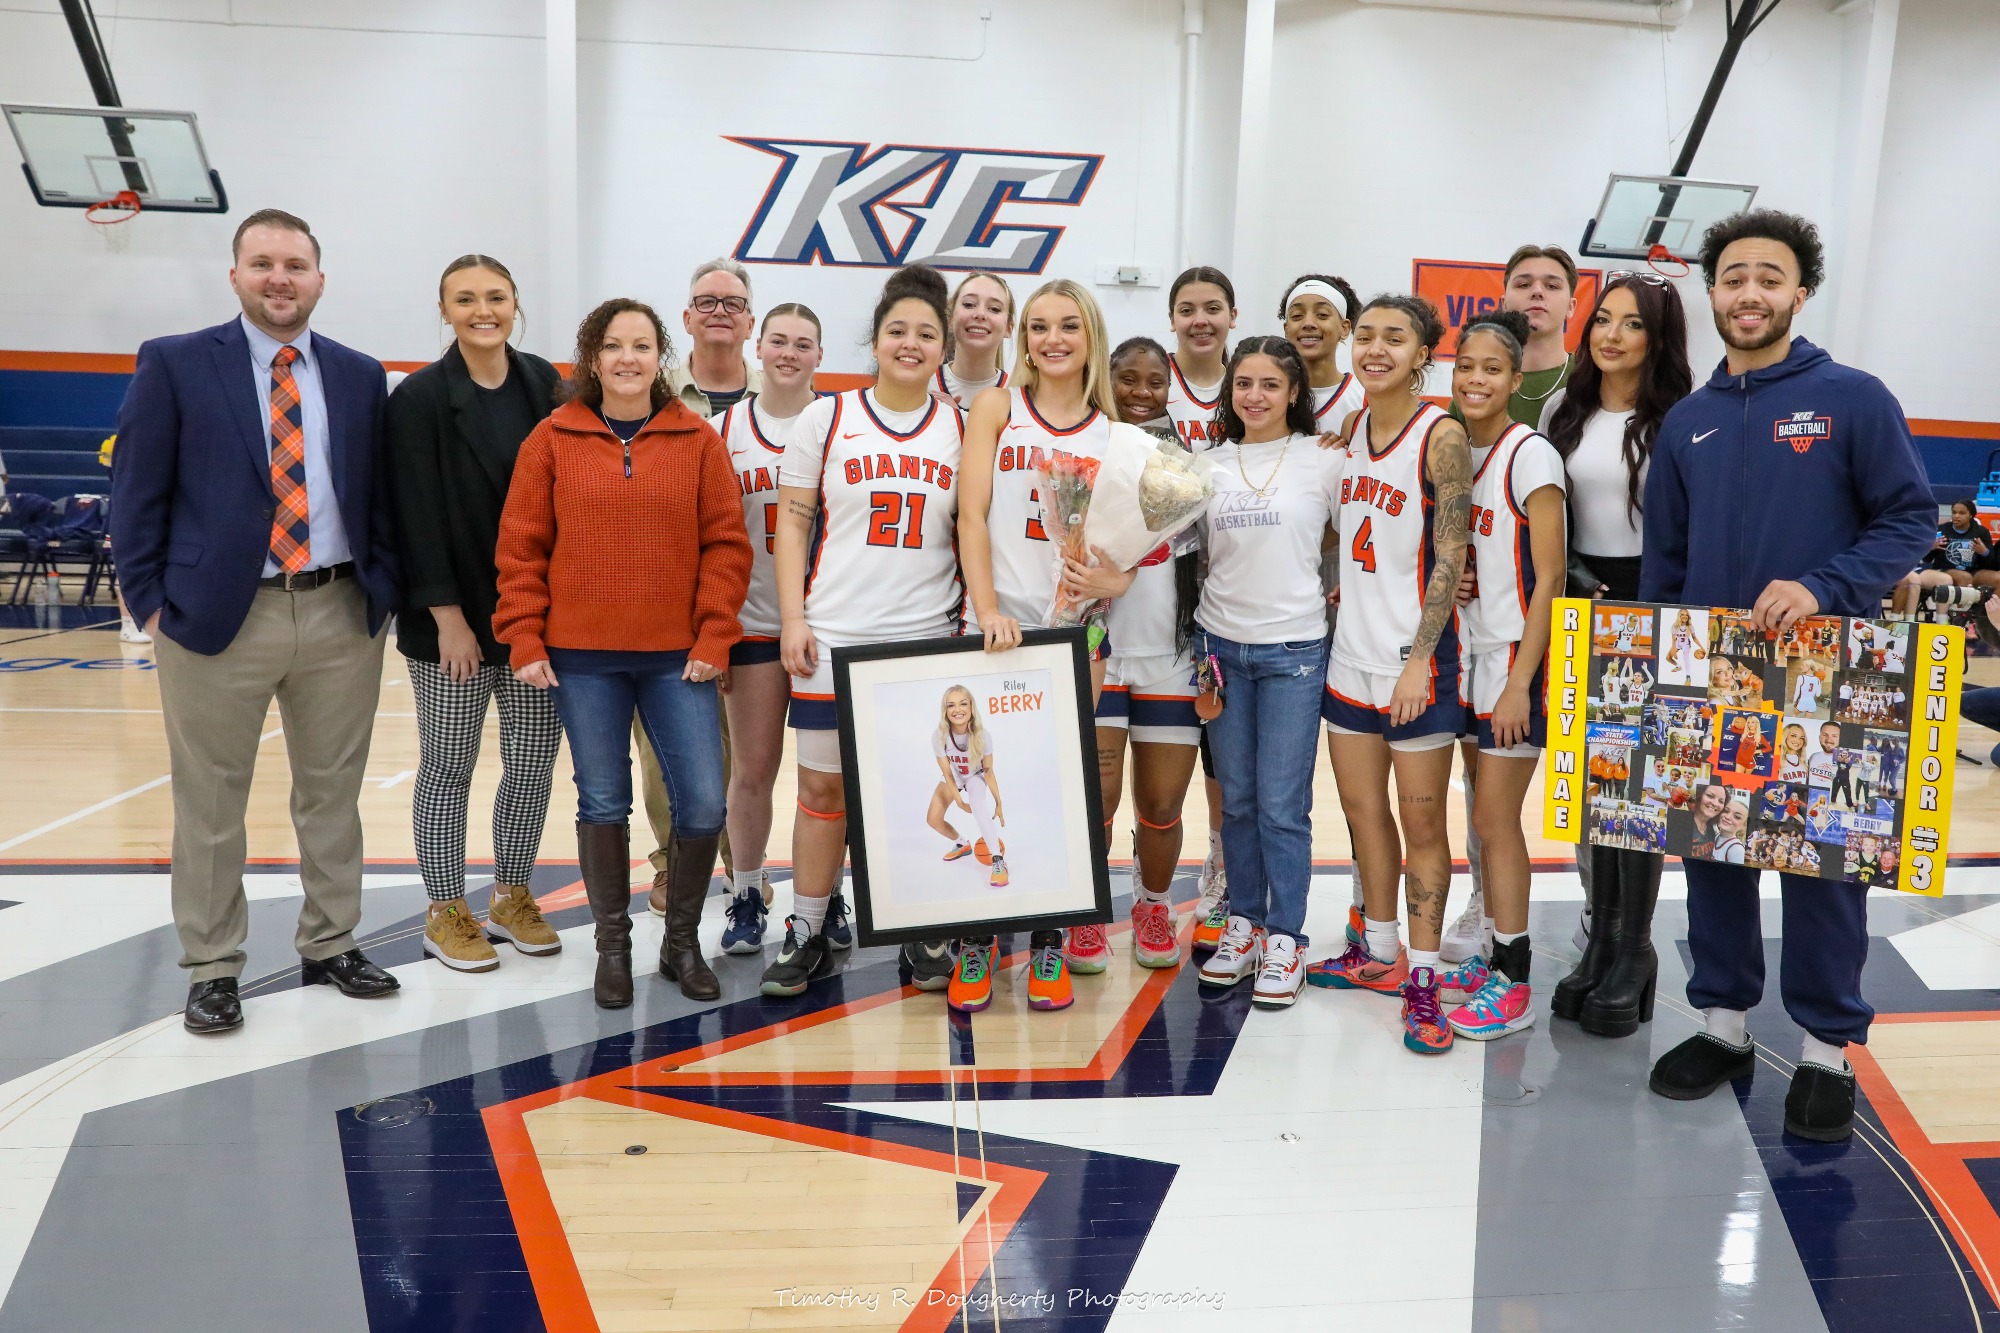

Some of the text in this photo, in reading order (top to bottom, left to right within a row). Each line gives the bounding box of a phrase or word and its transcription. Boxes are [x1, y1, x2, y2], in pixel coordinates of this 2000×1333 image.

[1791, 411, 1815, 422] KC
[1778, 422, 1826, 436] BASKETBALL
[844, 453, 953, 490] GIANTS
[1219, 487, 1279, 514] KC
[866, 491, 926, 549] 21
[1214, 512, 1281, 531] BASKETBALL
[1352, 515, 1377, 573] 4
[1003, 680, 1026, 692] Riley
[1808, 683, 1814, 692] 3
[988, 691, 1043, 714] BERRY
[1553, 608, 1579, 829] RILEY MAE
[1587, 737, 1639, 747] CHAMPIONSHIPS
[958, 765, 969, 775] 3
[1910, 635, 1949, 890] SENIOR #3
[1853, 818, 1882, 830] BERRY
